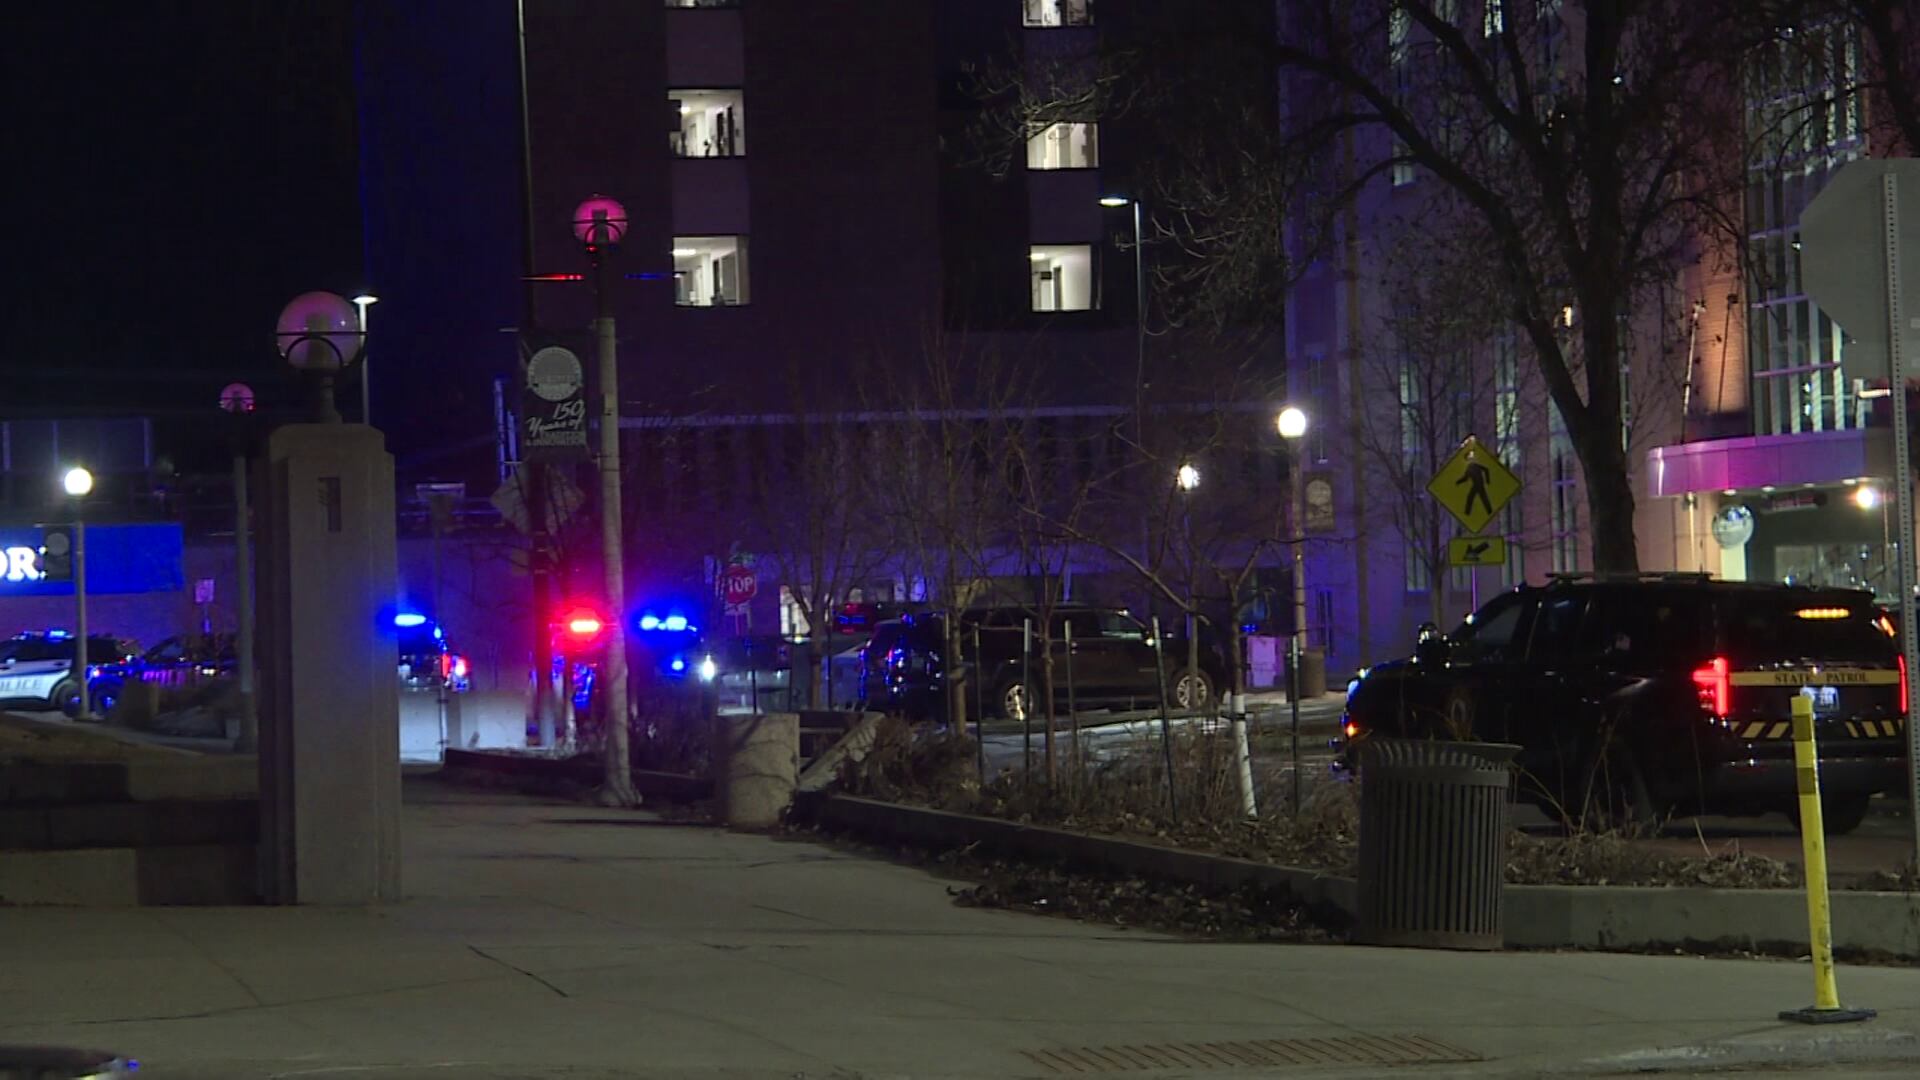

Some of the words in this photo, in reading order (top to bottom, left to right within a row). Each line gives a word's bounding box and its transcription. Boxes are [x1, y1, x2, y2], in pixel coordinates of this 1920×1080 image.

[552, 399, 585, 420] 150
[1775, 672, 1811, 683] STATE
[1826, 672, 1869, 683] PATROL
